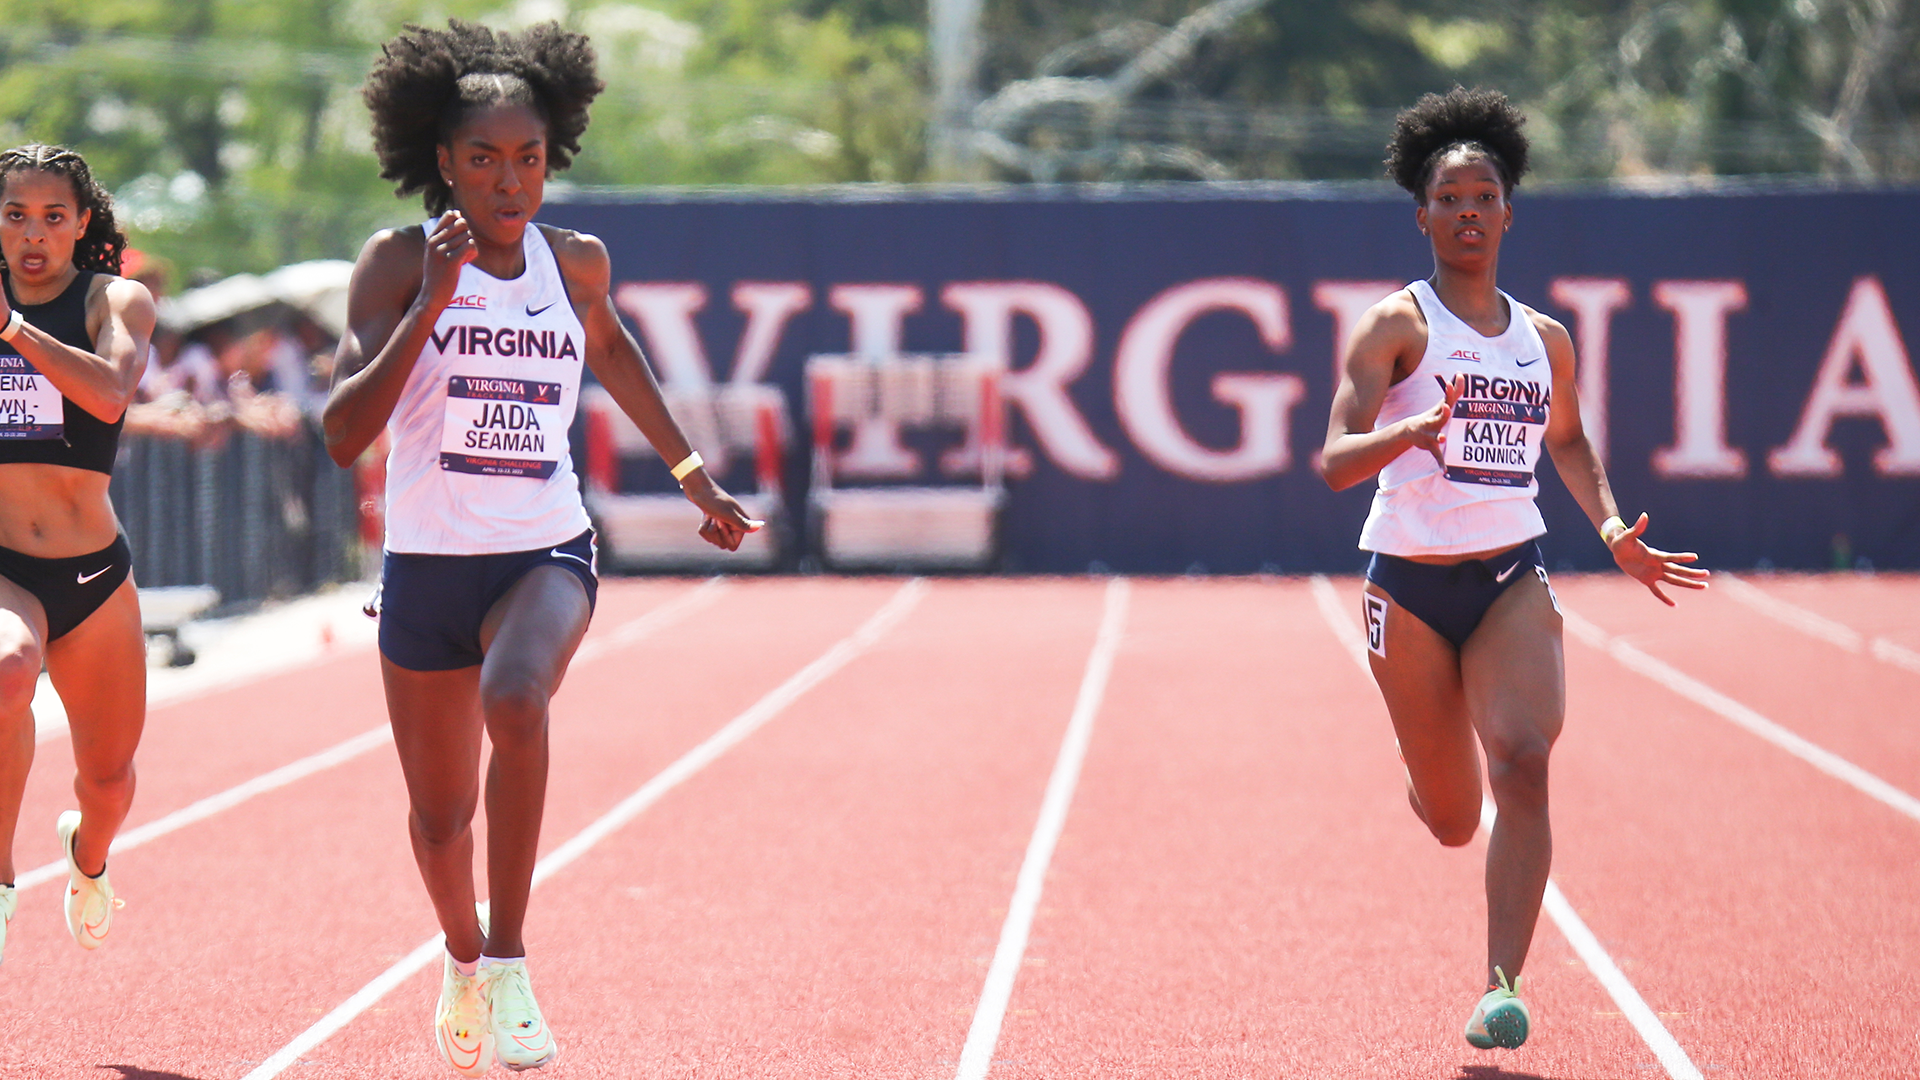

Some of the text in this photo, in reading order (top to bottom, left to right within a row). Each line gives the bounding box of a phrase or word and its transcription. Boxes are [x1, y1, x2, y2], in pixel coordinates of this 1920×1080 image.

[447, 295, 487, 308] ACC
[430, 325, 578, 361] VIRGINIA
[1450, 350, 1481, 361] ACC
[0, 376, 38, 391] ENA
[466, 379, 525, 394] VIRGINIA
[473, 403, 540, 430] JADA
[1467, 402, 1516, 416] VIRGINIA
[465, 429, 544, 453] SEAMAN
[1464, 421, 1527, 447] KAYLA
[465, 457, 542, 470] VIRGINIA CHALLENGE
[1463, 444, 1526, 465] BONNICK
[1368, 598, 1383, 641] 5
